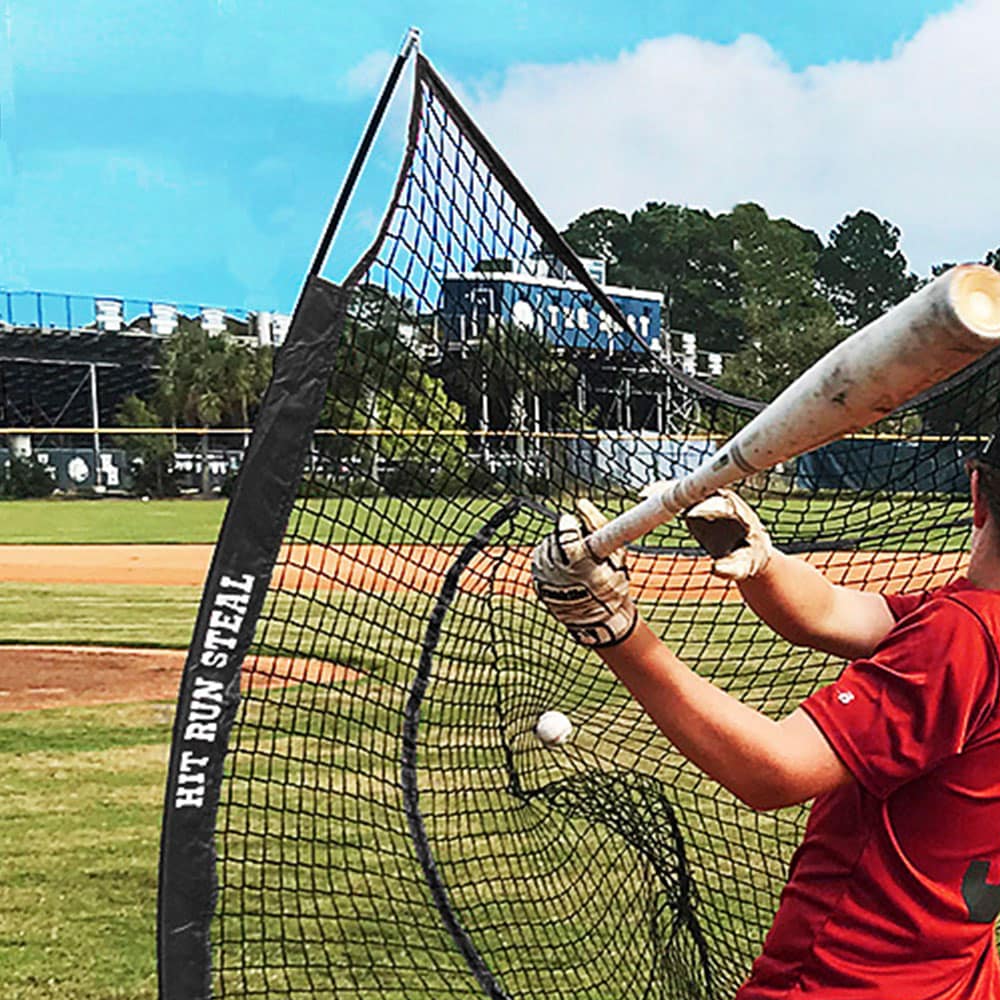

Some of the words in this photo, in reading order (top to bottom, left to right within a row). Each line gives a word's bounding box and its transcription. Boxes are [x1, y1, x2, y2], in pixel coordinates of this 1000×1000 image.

[201, 573, 256, 669] STEAL
[184, 677, 225, 742] RUN
[175, 751, 209, 809] HIT
